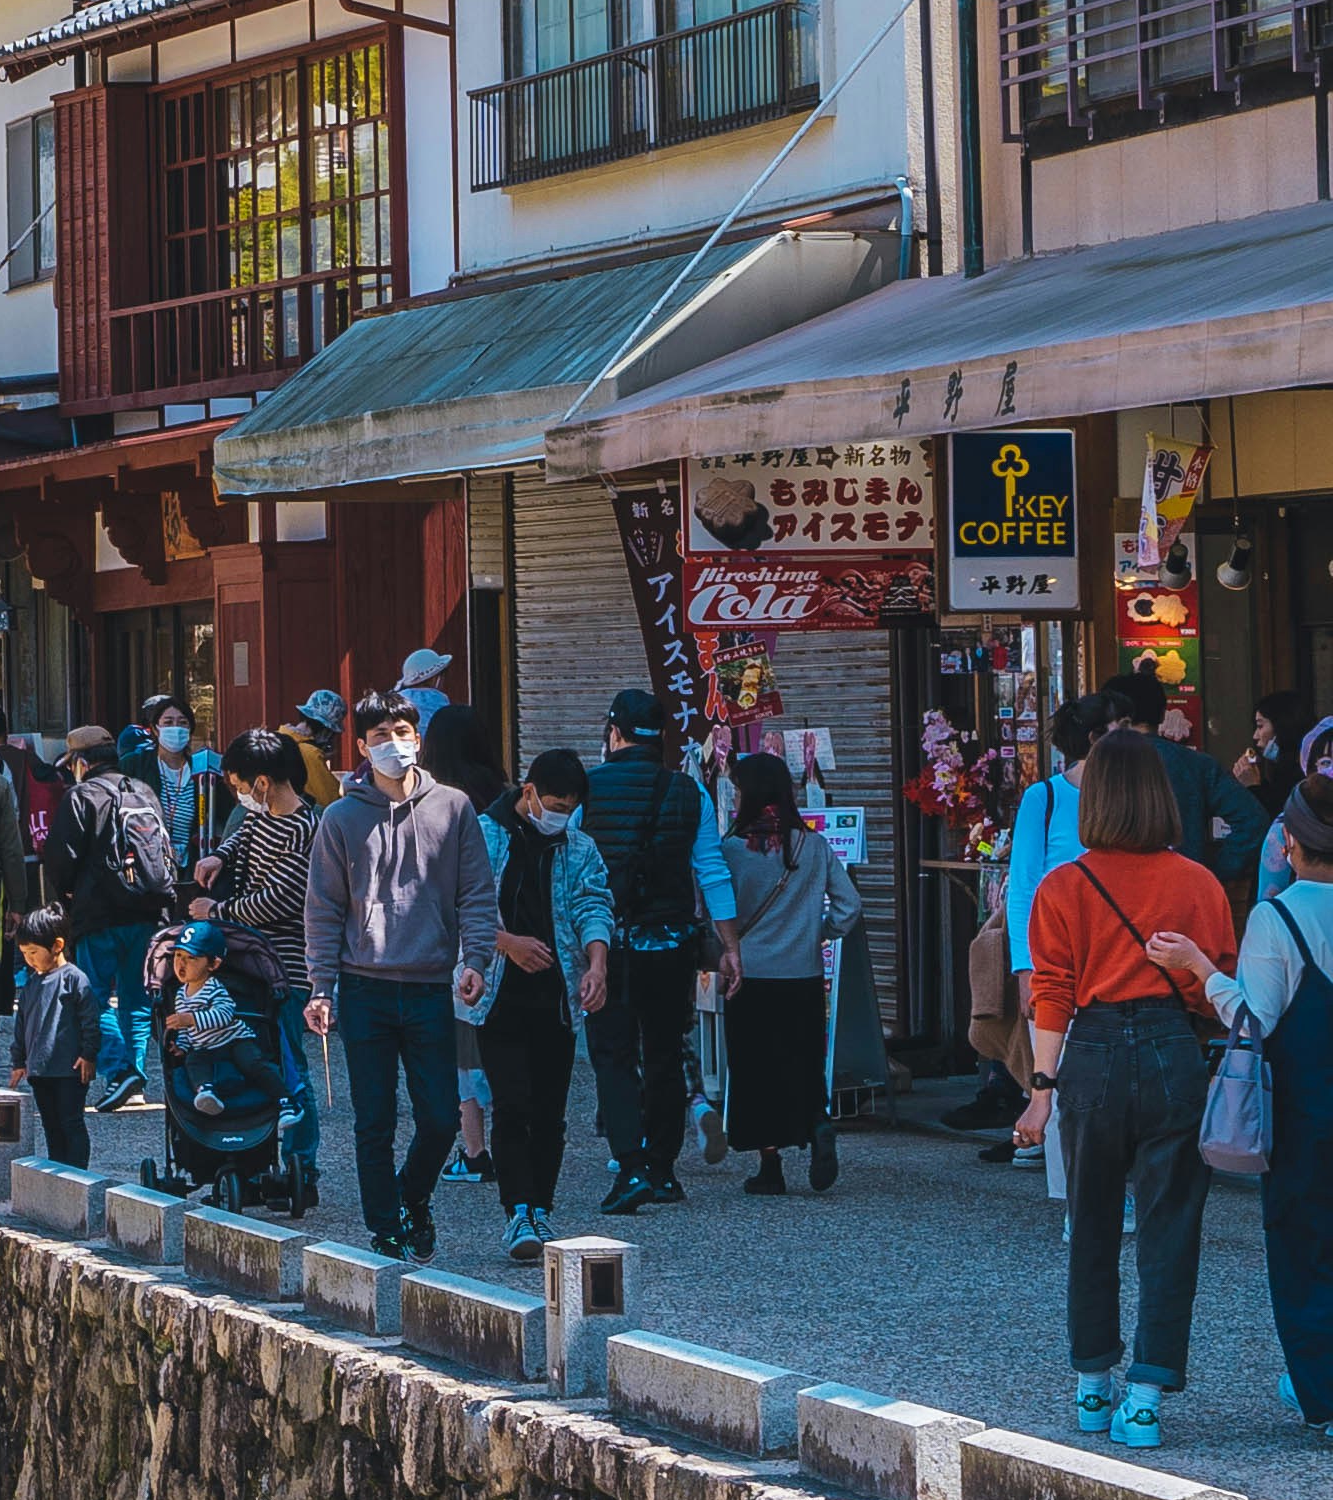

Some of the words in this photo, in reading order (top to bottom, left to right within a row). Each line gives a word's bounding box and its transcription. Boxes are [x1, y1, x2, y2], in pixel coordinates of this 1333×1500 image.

[892, 361, 1018, 429] 平野屋
[844, 444, 911, 467] 新名物
[769, 477, 923, 507] もみじまん
[1016, 496, 1068, 517] KEY
[773, 511, 933, 543] アイスモナ
[959, 521, 1067, 545] COFFEE
[693, 567, 820, 591] Hiroshima
[979, 574, 1052, 595] 平野屋
[688, 583, 820, 625] Cola
[180, 927, 195, 943] S
